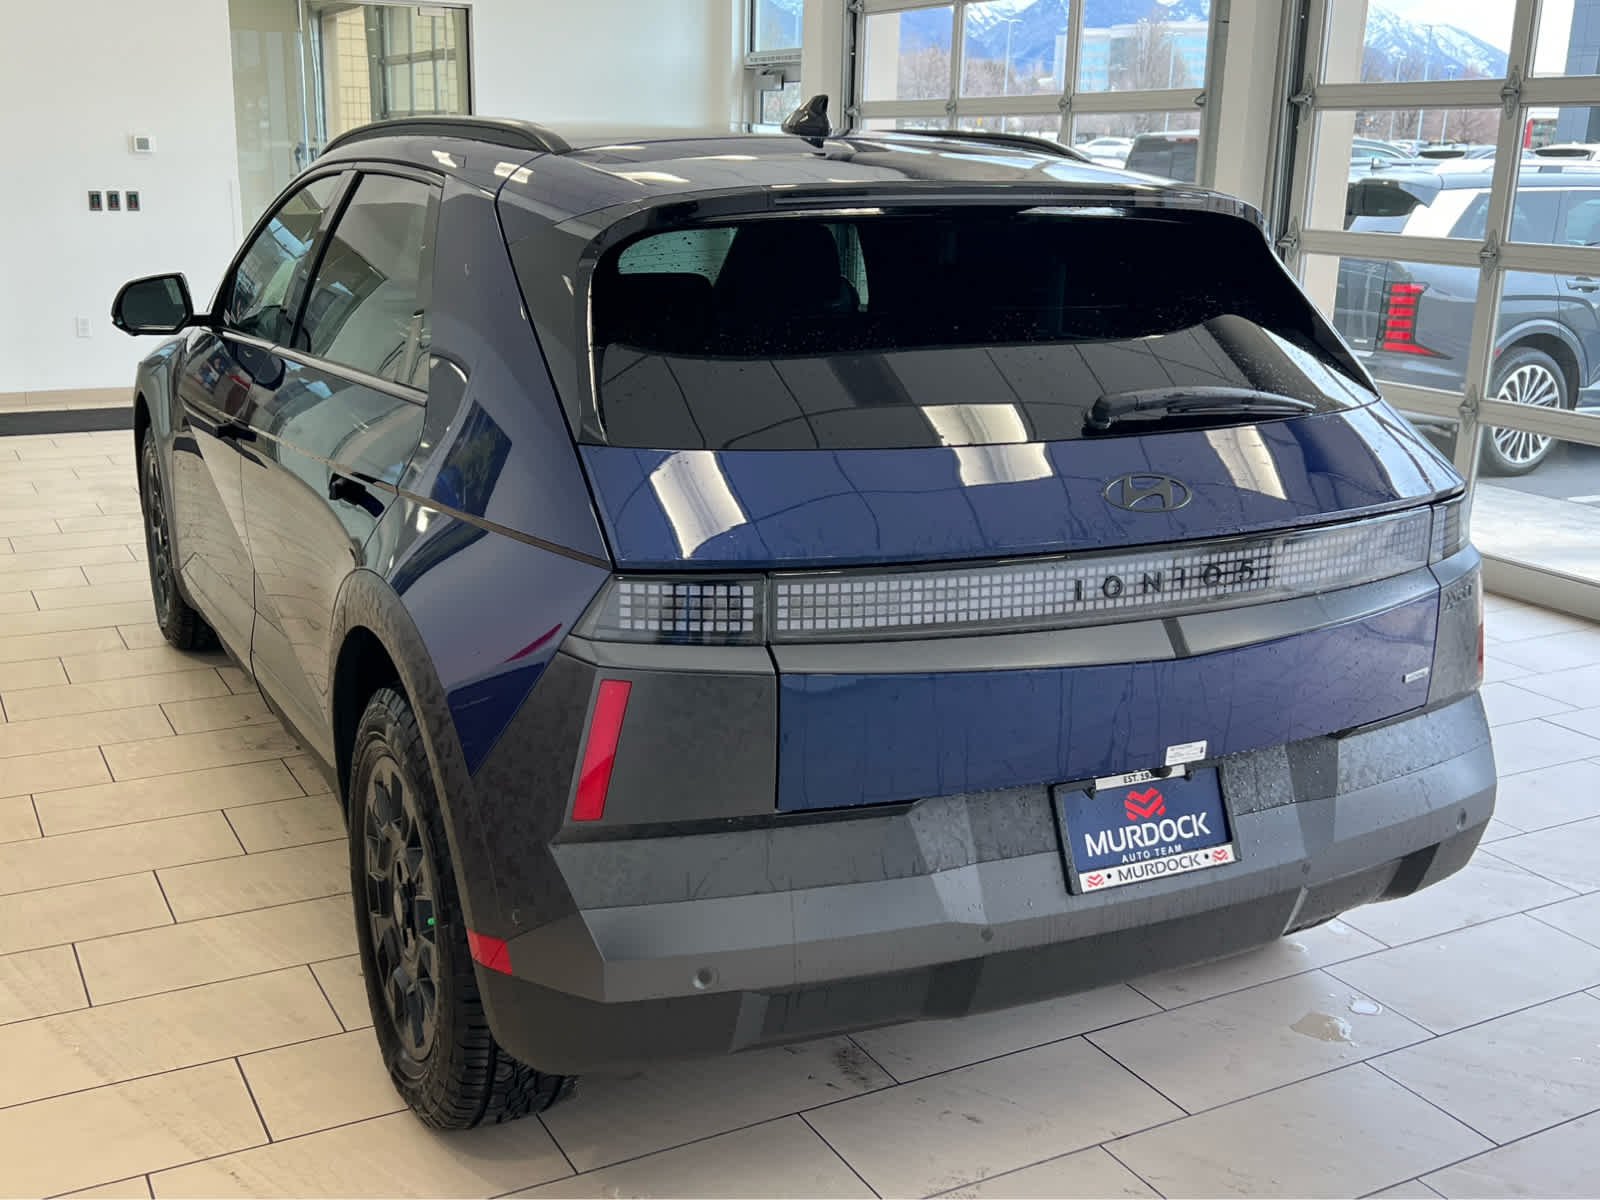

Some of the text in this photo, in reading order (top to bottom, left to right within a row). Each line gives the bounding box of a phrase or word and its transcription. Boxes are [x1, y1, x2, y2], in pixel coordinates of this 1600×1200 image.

[1240, 559, 1254, 583] 5
[1123, 774, 1140, 784] EST.
[1084, 812, 1211, 857] MURDOCK
[1121, 844, 1182, 863] AUTO TEAM
[1117, 853, 1201, 882] MURDOCK
